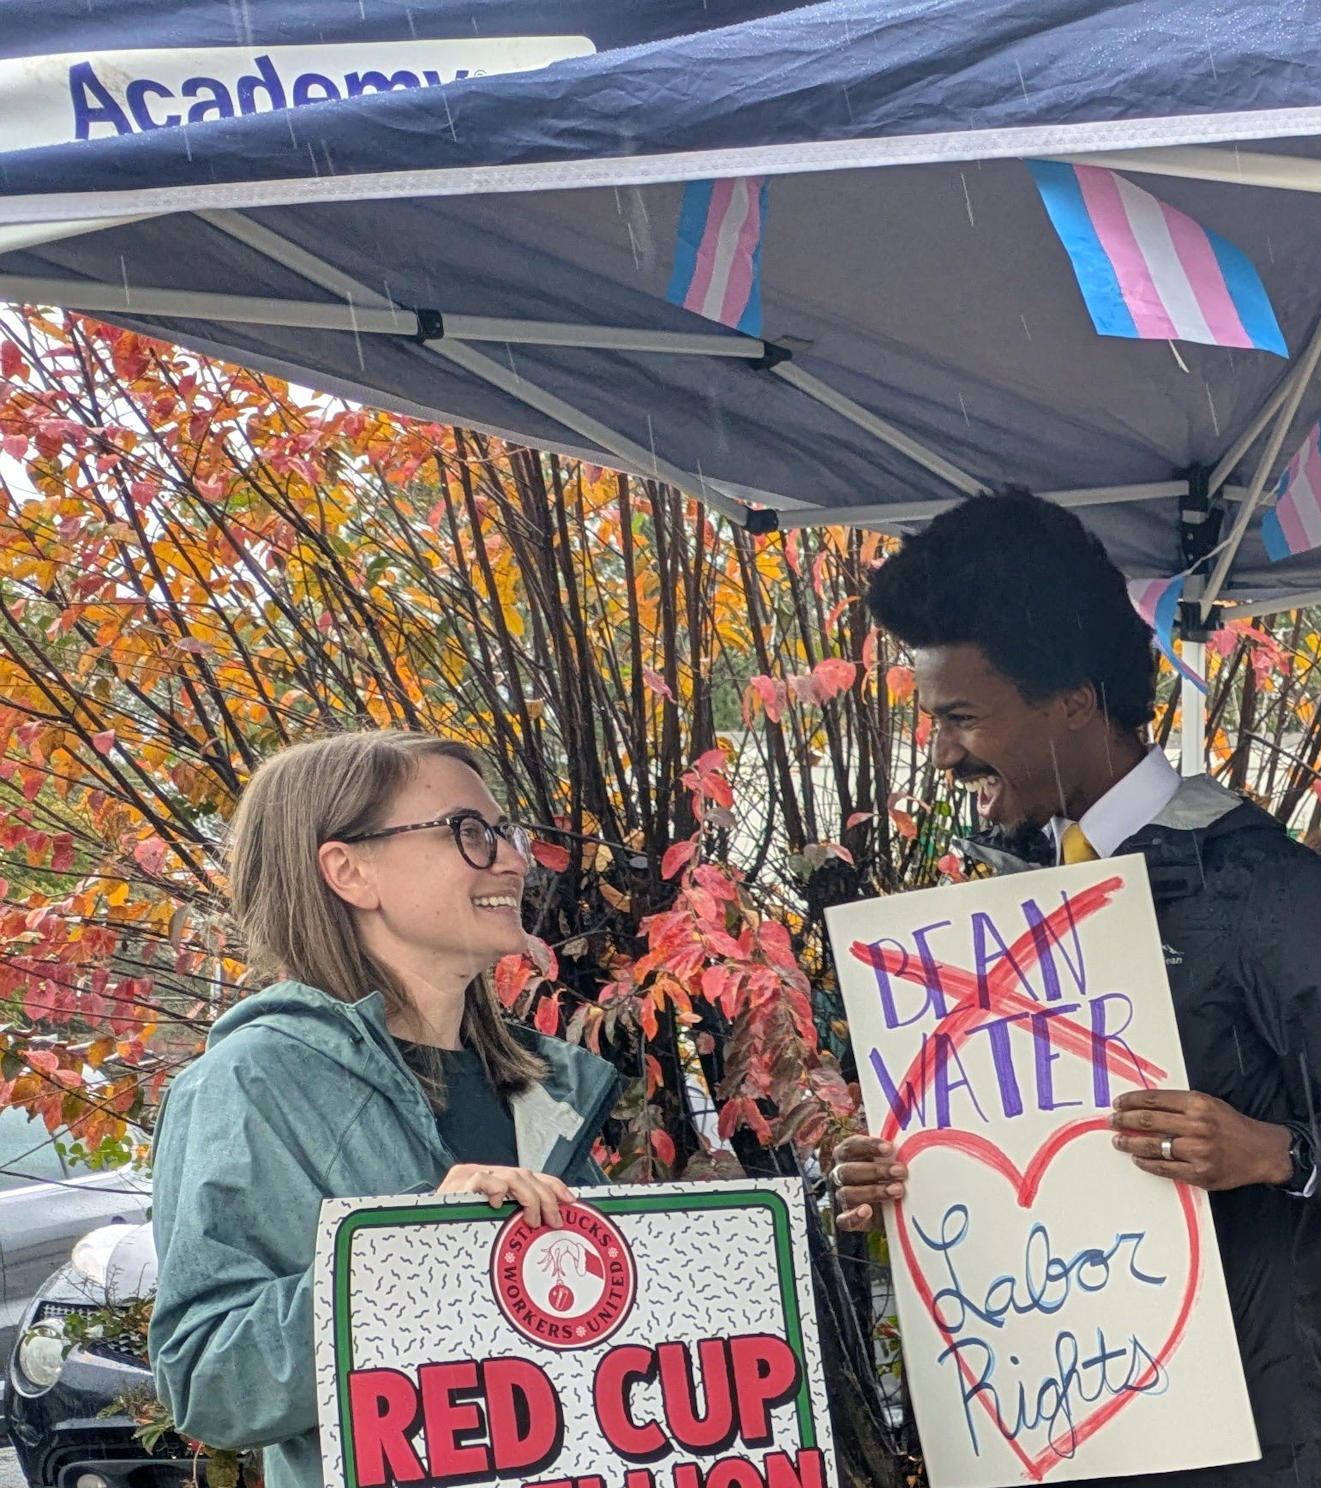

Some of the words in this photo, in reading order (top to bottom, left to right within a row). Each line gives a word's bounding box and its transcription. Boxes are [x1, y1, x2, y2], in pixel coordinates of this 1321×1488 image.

[868, 891, 1086, 1029] BEAN
[869, 993, 1152, 1130] WATER
[510, 1210, 612, 1251] STUCKS
[586, 1261, 624, 1332] UNITED
[912, 1203, 1167, 1334] Labor
[504, 1265, 573, 1338] WORKERS
[348, 1355, 564, 1488] RED
[593, 1334, 803, 1462] CUP
[937, 1326, 1170, 1459] Rights
